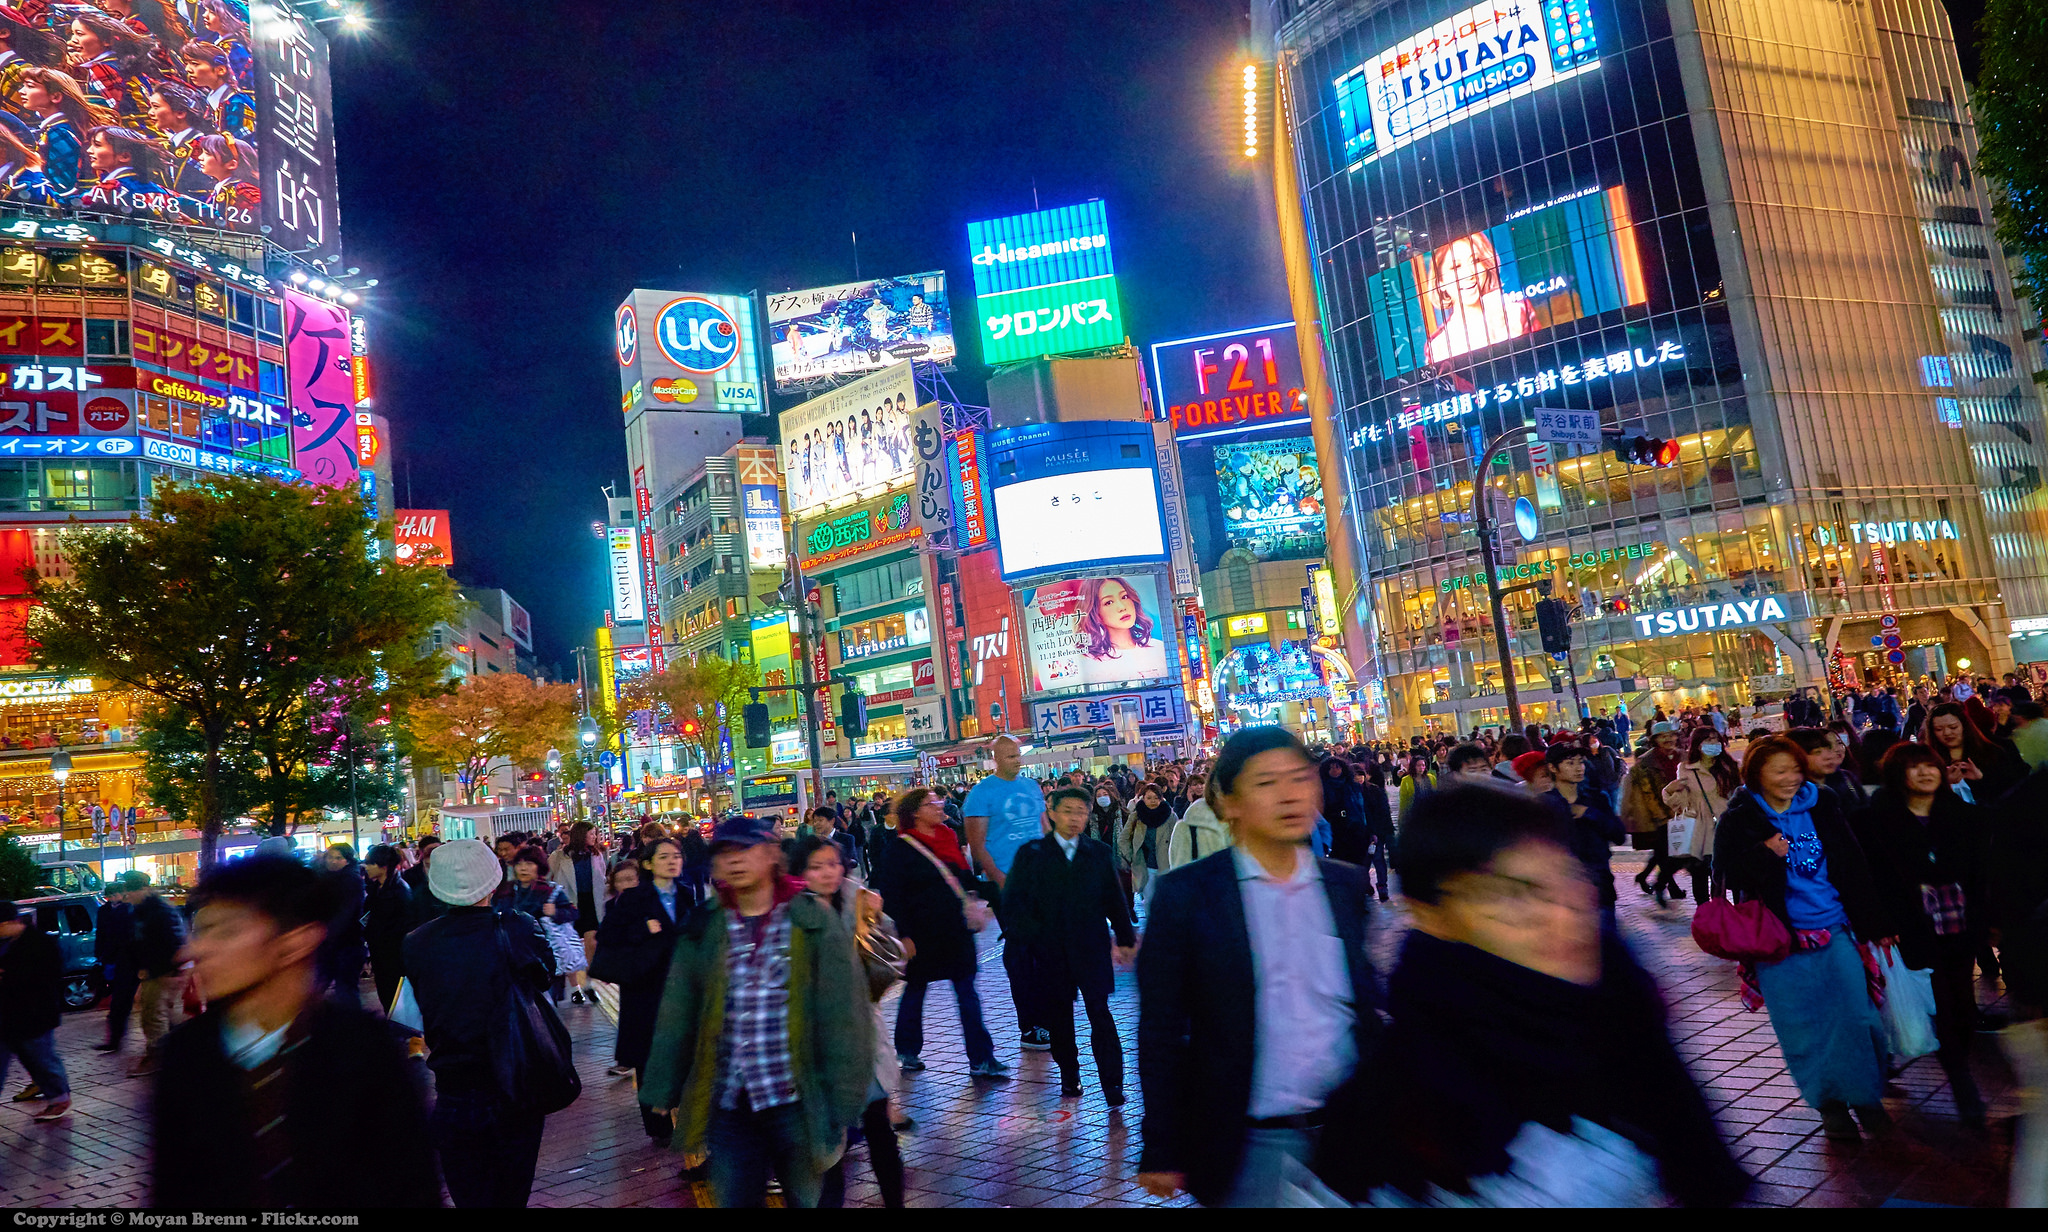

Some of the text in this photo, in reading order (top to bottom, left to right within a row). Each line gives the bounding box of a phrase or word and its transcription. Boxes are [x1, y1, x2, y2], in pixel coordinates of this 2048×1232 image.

[1402, 24, 1539, 97] TSUTAYA
[1458, 61, 1528, 101] MUSICO
[8, 175, 78, 196] レイン
[92, 187, 252, 224] AKB48 11.26
[972, 233, 1106, 266] Hisamitsu
[770, 287, 864, 314] ゲスの極み乙女
[987, 298, 1113, 340] サロンパス
[619, 318, 635, 354] UC
[666, 316, 733, 354] UC
[134, 327, 255, 380] コンタクト
[1194, 338, 1278, 394] F21
[13, 364, 103, 392] ガスト
[653, 385, 698, 396] MasterCard
[153, 378, 226, 409] Caféレストラン
[722, 387, 755, 399] VISA
[90, 412, 125, 421] ガスト
[228, 395, 281, 425] ガスト
[1170, 390, 1284, 430] FOREVER
[1541, 413, 1596, 431] 渋谷駅前
[2, 438, 126, 454] イーオン 6F
[1018, 430, 1051, 441] Channel
[1551, 430, 1591, 441] Shibuya Sta.
[149, 440, 192, 463] AEON
[914, 419, 950, 526] もんじゃ
[959, 437, 981, 538] 三千里薬品
[398, 516, 436, 538] H&M
[748, 520, 780, 531] 夜11時
[755, 532, 776, 542] まで
[834, 518, 871, 547] 西村
[1164, 501, 1183, 551] neon
[1850, 519, 1958, 544] TSUTAYA
[1441, 542, 1655, 593] STARUCKS COFFEE
[618, 551, 633, 620] Essential
[1032, 609, 1087, 634] 西野カナ
[1635, 597, 1787, 637] TSUTAYA
[847, 635, 906, 657] Euphoria
[1036, 633, 1089, 651] with LOVE
[1056, 628, 1073, 637] Album
[1917, 636, 1946, 645] COFFEE
[816, 647, 826, 682] ルーツギフ
[973, 617, 1008, 685] クスリ
[1040, 648, 1089, 661] 11.12 Release!
[915, 662, 934, 682] JTB
[4, 761, 50, 771] L'OCCITA
